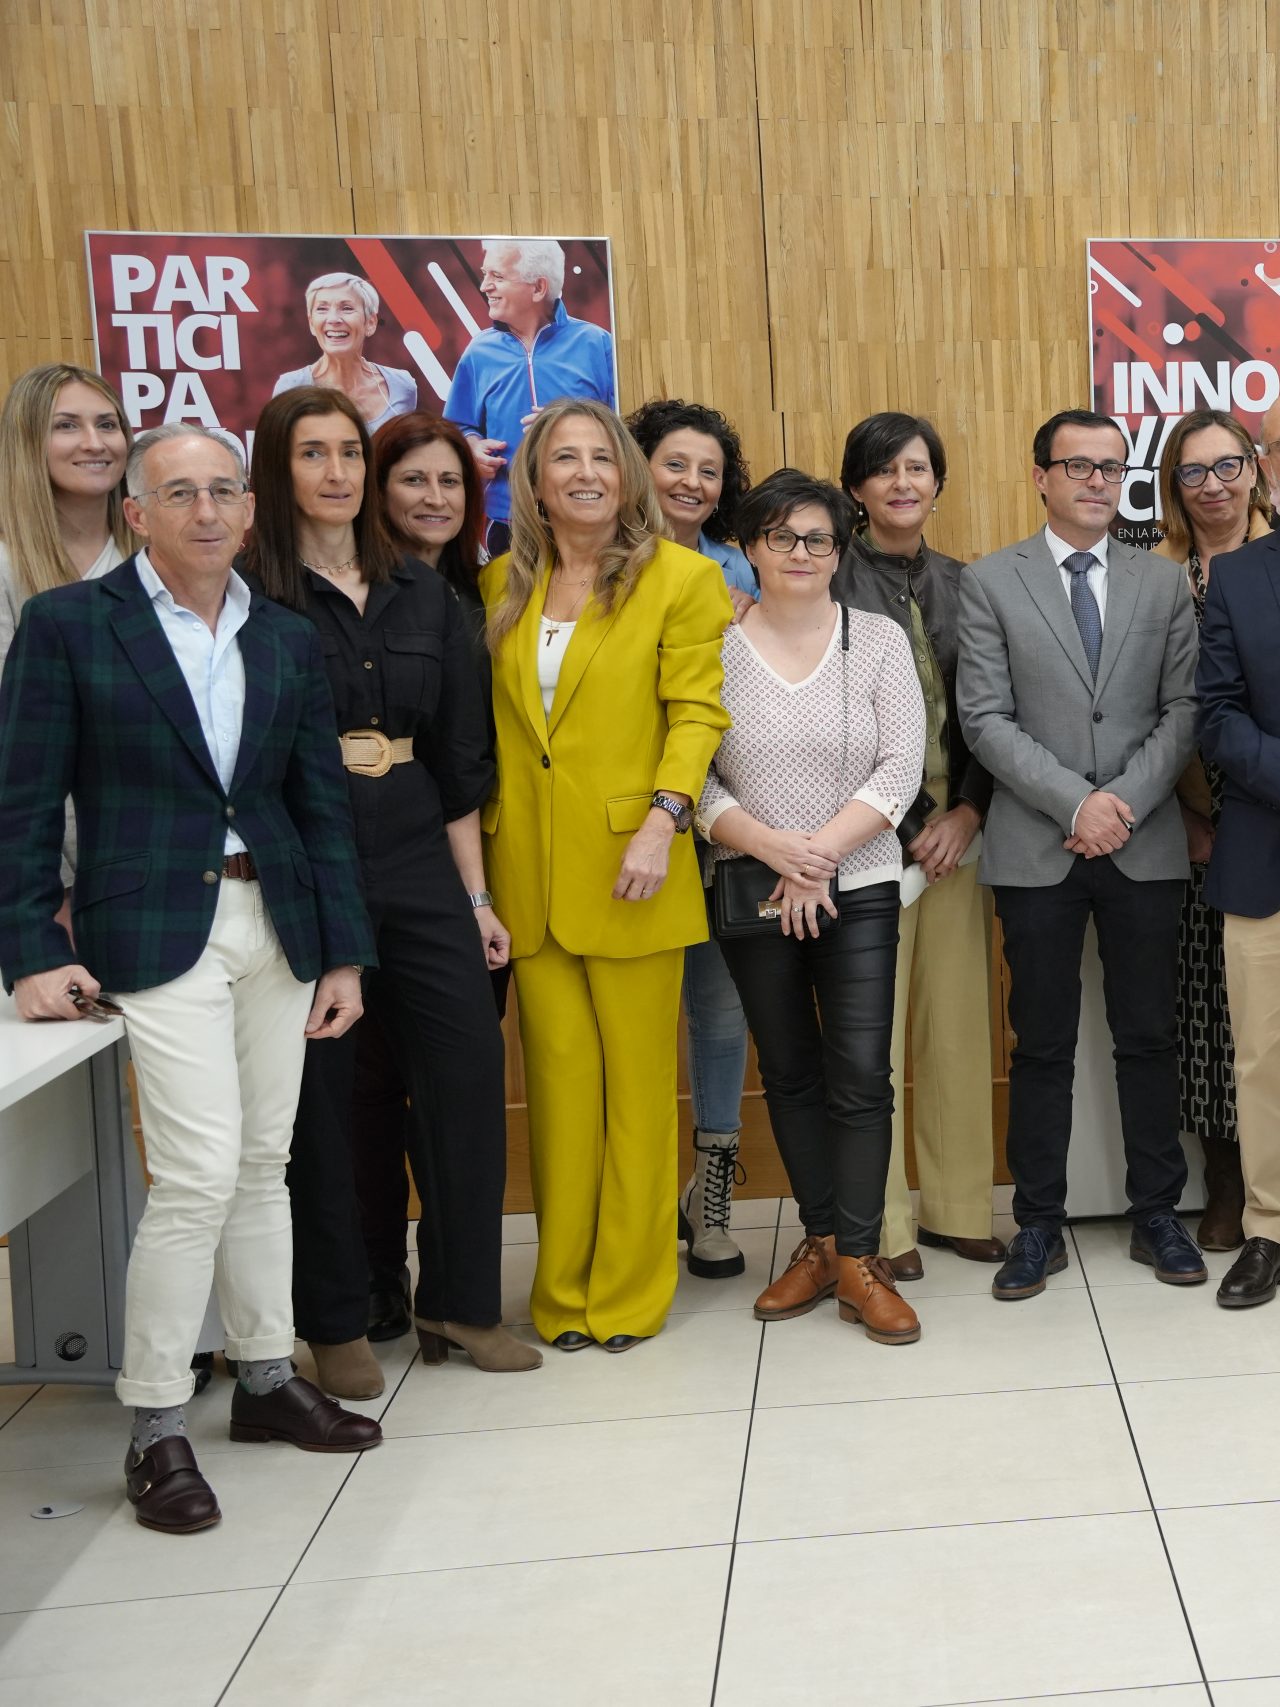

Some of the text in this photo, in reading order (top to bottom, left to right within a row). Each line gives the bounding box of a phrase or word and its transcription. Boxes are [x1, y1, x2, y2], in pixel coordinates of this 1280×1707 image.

[110, 254, 259, 312] PAR
[111, 313, 242, 371] TICI
[120, 371, 222, 428] PA
[1113, 360, 1280, 414] INNO
[1117, 527, 1134, 539] EN
[1137, 527, 1149, 539] LA
